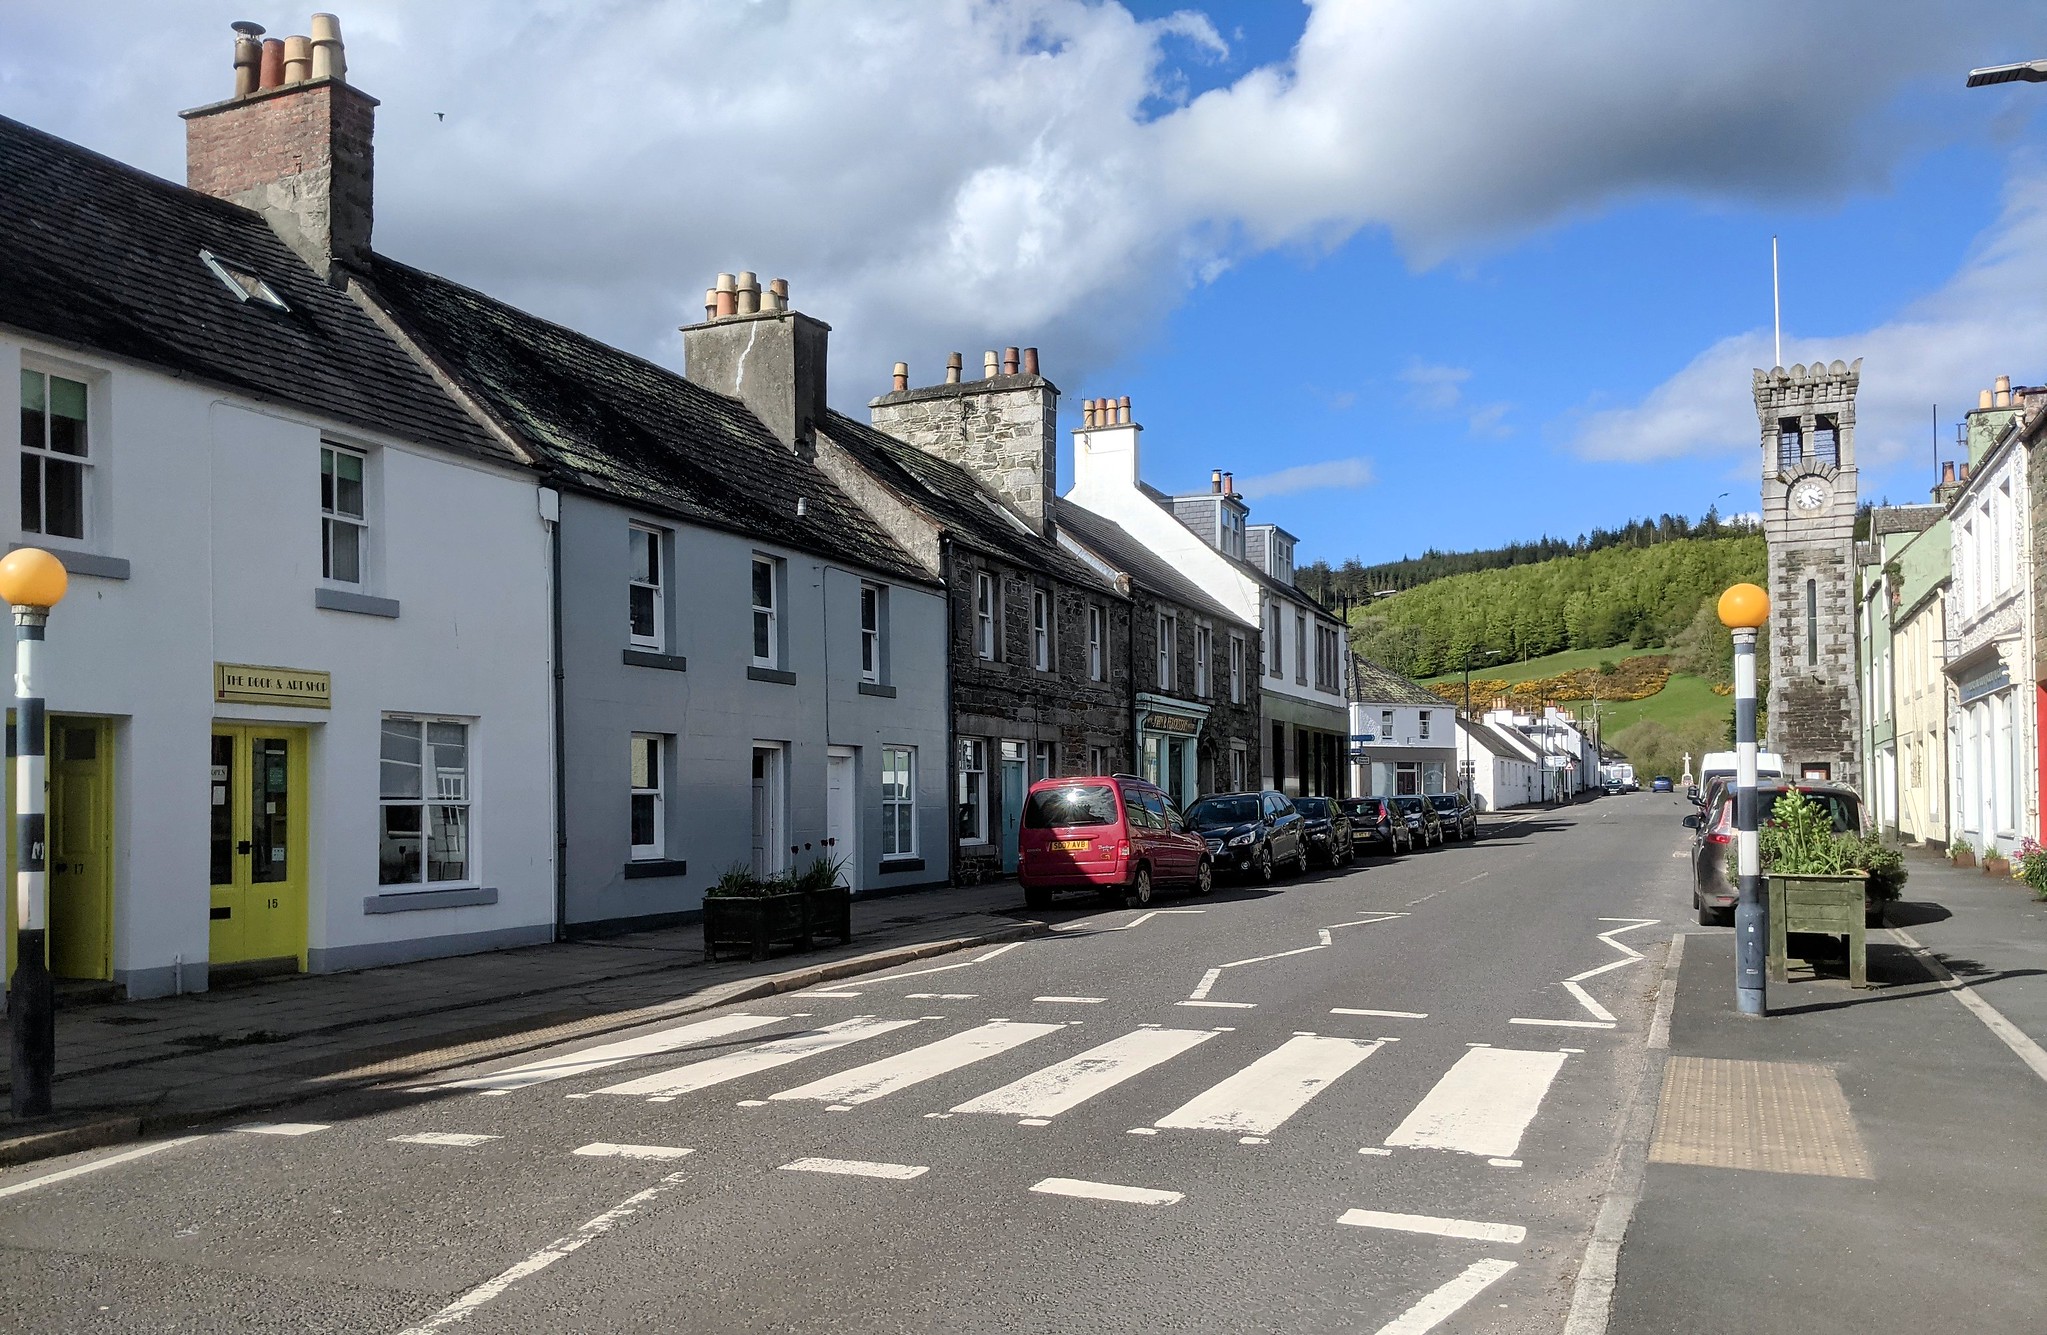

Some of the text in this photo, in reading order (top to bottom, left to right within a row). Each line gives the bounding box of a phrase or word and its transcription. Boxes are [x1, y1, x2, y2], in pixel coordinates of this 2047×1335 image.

[226, 675, 328, 692] THE BOOK & ART SHOP
[74, 863, 84, 875] 17
[267, 899, 278, 909] 15
